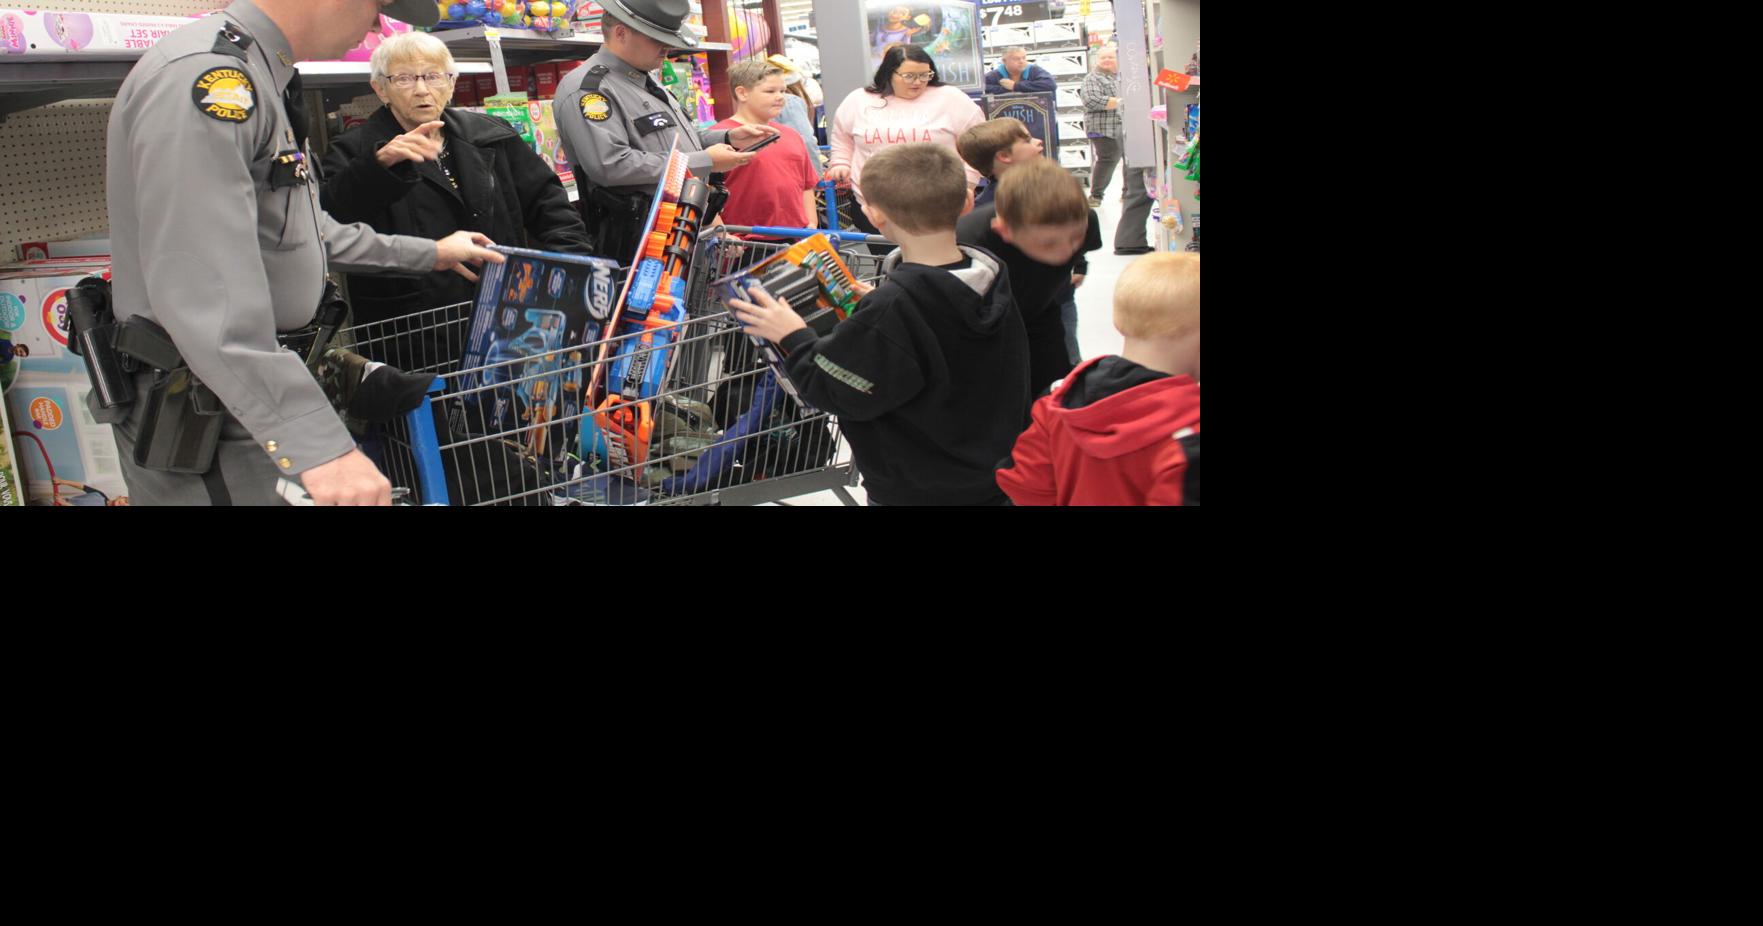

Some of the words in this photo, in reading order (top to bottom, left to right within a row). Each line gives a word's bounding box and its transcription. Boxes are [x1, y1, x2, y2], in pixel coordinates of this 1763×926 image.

[131, 29, 149, 38] SET
[196, 69, 253, 92] KENTUCKY
[1003, 109, 1034, 123] WISH
[865, 128, 883, 144] LA
[887, 128, 907, 144] LA
[592, 261, 610, 318] NERF
